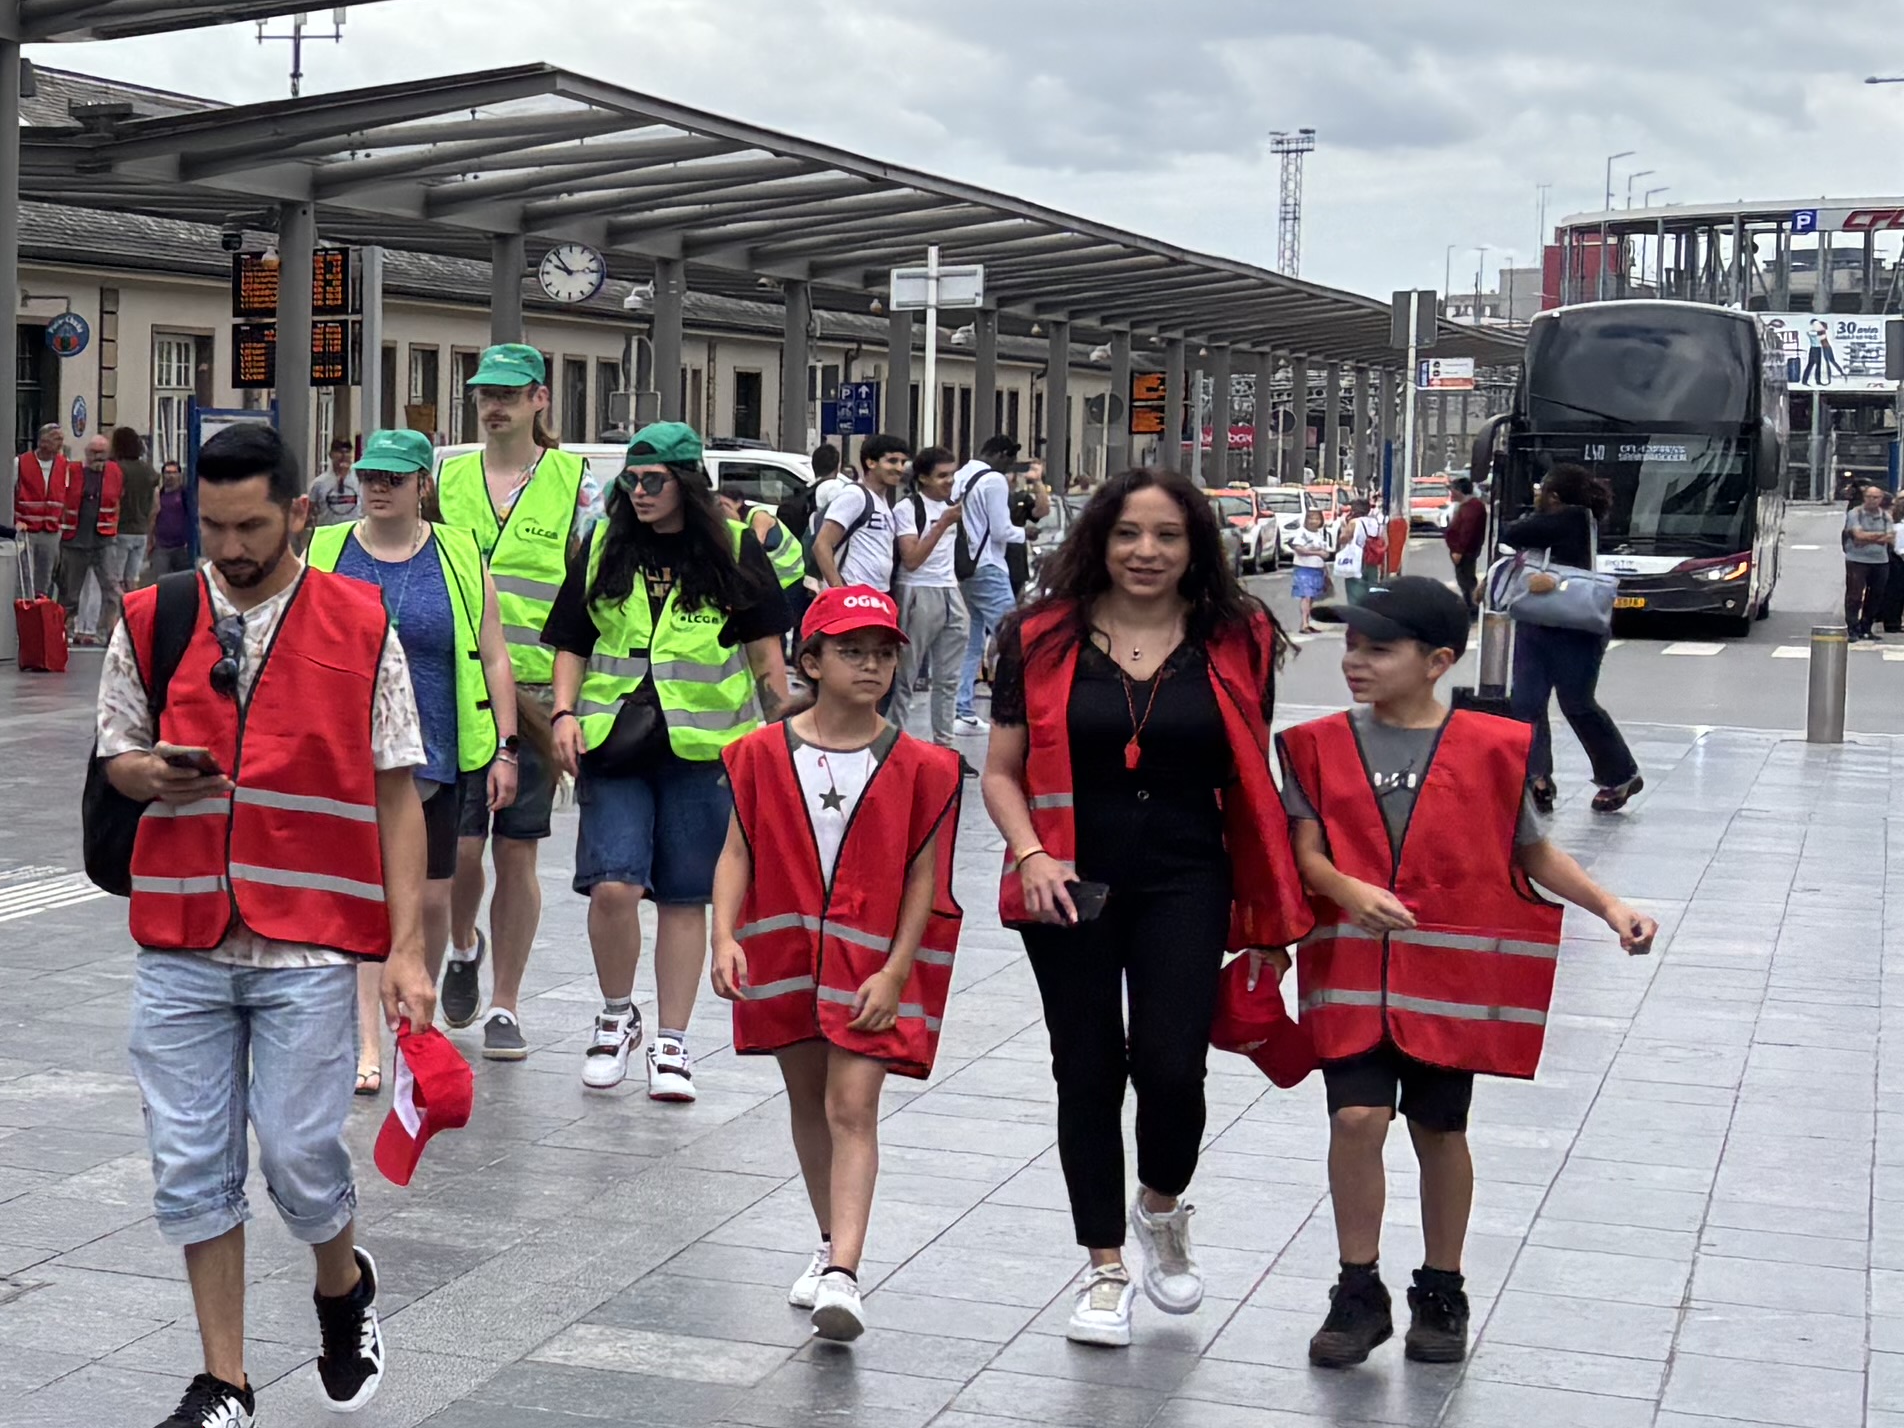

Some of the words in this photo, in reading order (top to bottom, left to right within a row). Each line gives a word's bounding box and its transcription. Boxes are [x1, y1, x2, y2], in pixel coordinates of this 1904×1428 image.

[1797, 215, 1811, 230] P
[1837, 321, 1857, 334] 30
[842, 388, 851, 400] P
